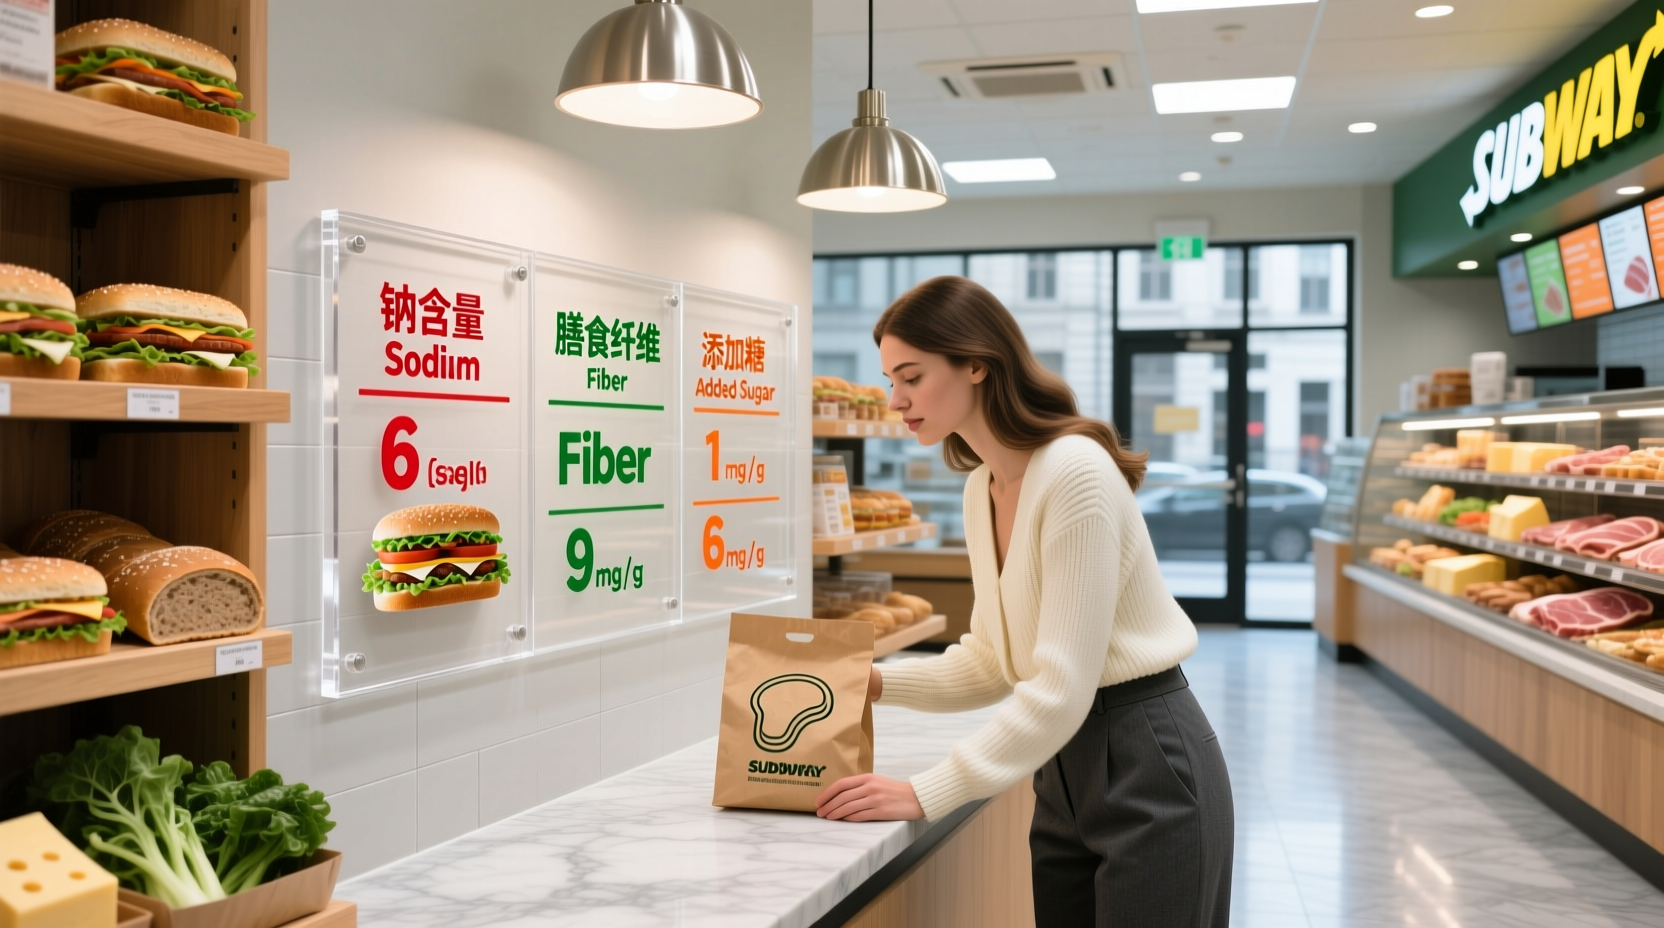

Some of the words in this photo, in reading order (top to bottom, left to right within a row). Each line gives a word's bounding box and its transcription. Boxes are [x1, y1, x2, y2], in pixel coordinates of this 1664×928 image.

[1459, 9, 1664, 228] SUBWAY
[380, 282, 485, 341] 钠含量
[555, 311, 661, 363] 膳食纤维
[701, 331, 766, 374] 添加糖
[587, 367, 628, 392] Fiber
[695, 377, 737, 399] Added
[739, 379, 776, 406] Sugar
[381, 415, 420, 491] 6
[560, 431, 652, 485] Fiber
